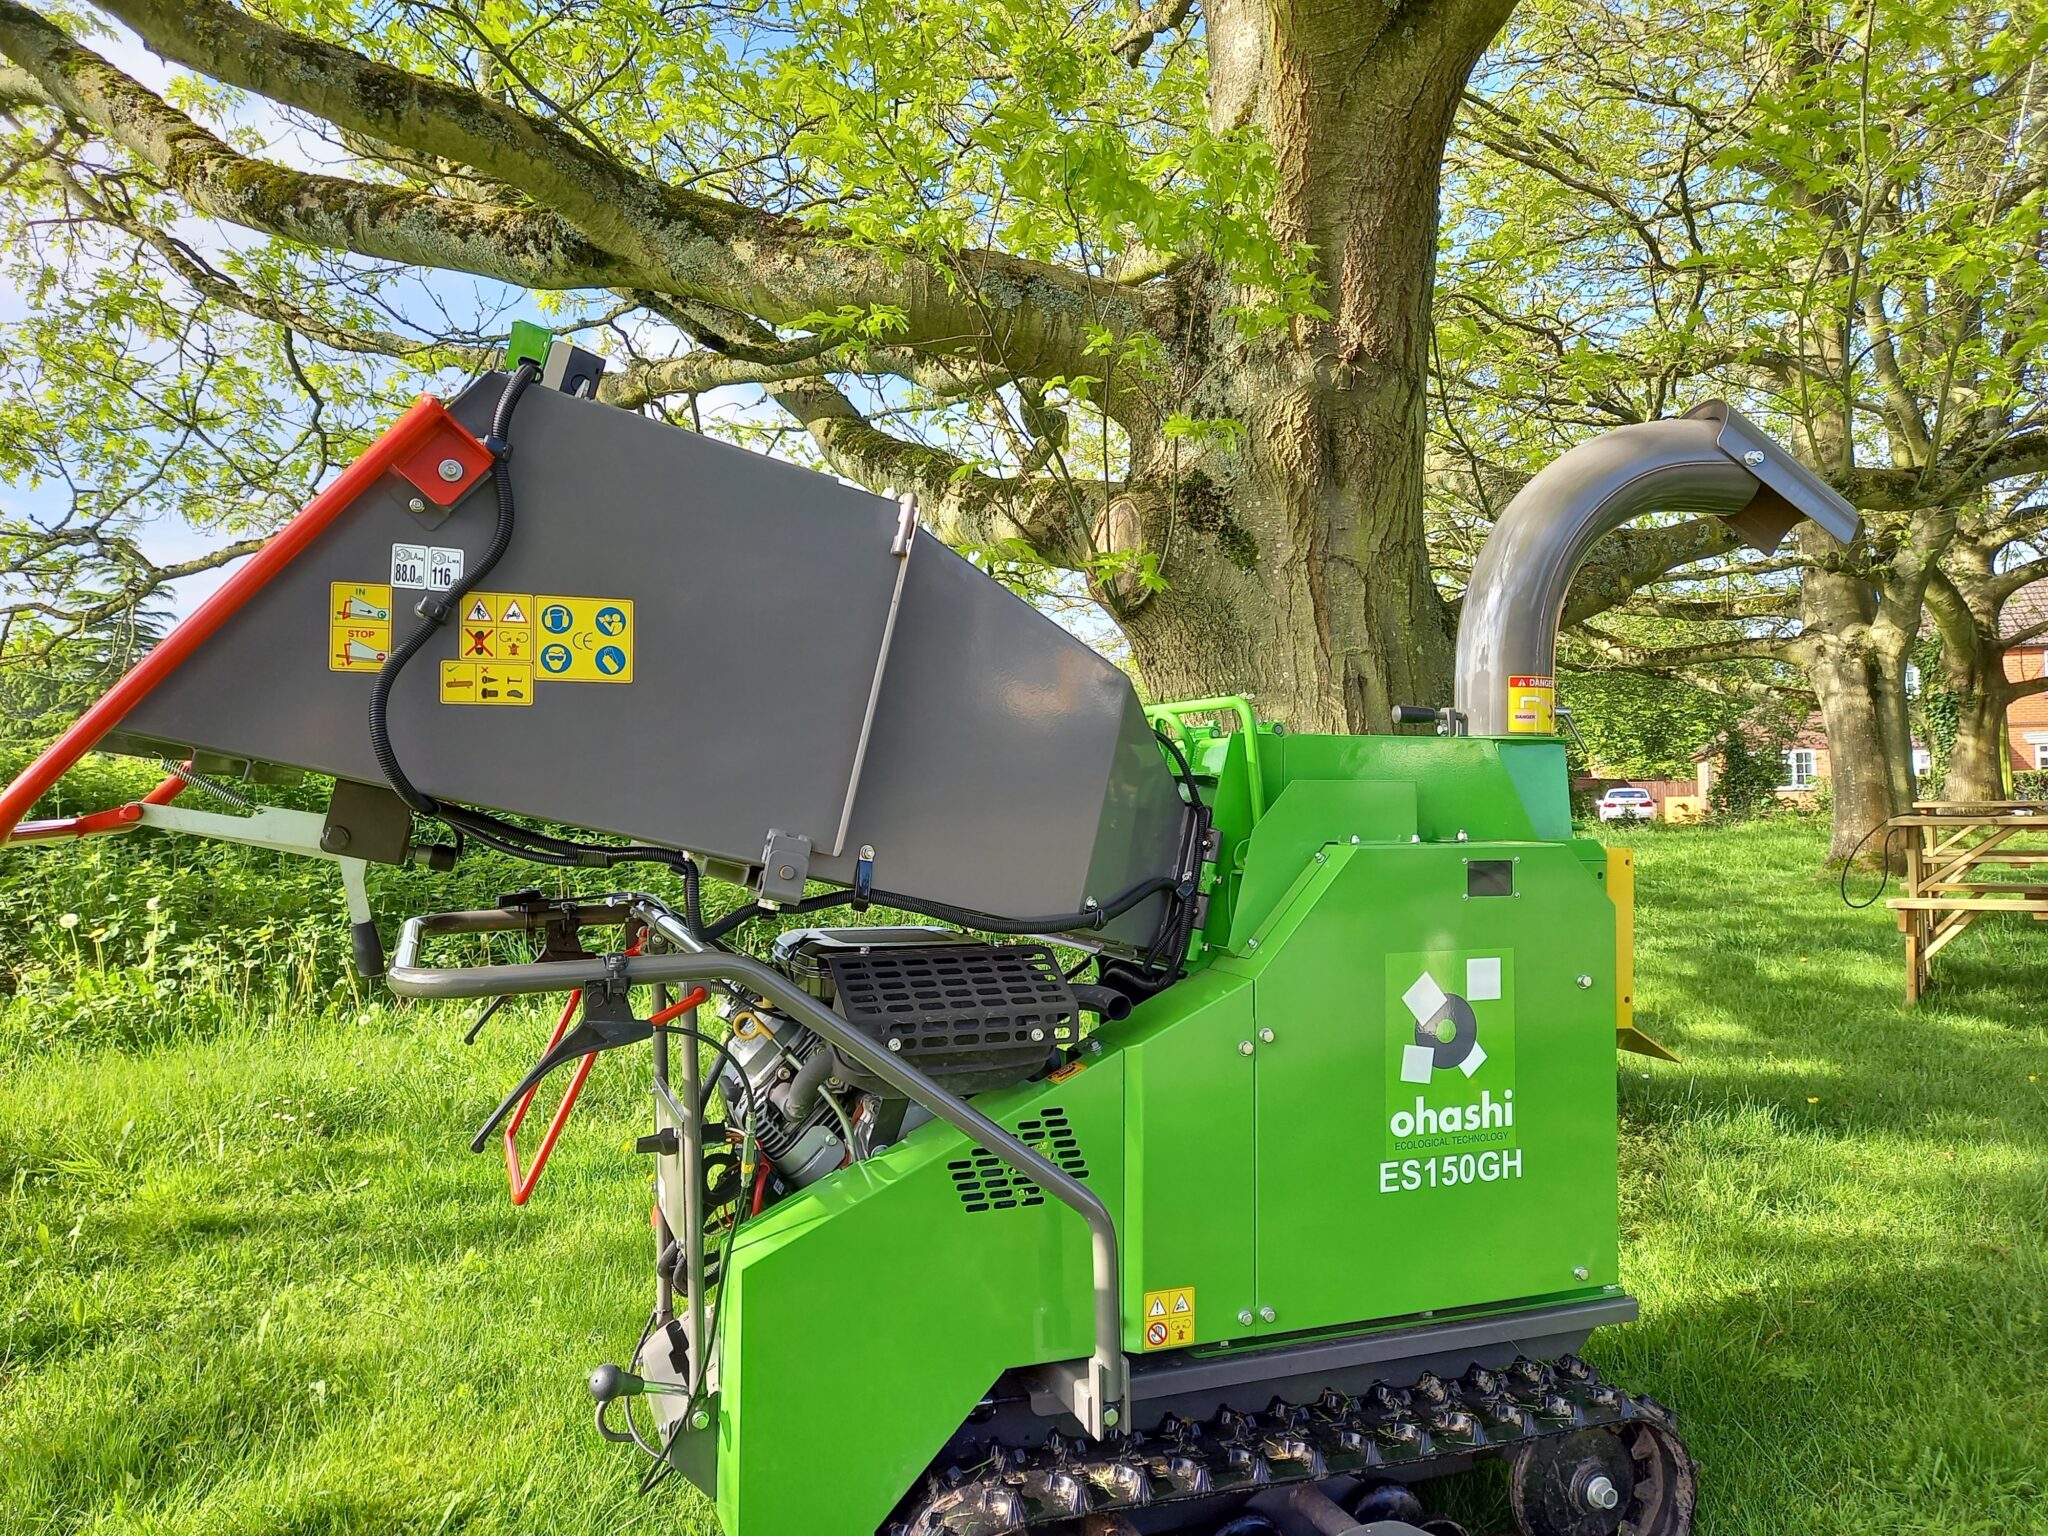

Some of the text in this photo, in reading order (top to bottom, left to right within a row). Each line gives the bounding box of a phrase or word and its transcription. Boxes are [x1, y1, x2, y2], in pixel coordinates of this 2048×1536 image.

[432, 567, 451, 586] 116
[355, 588, 365, 596] IN
[347, 630, 375, 638] STOP
[572, 631, 593, 651] CE
[1390, 1089, 1513, 1138] ohashi
[1395, 1131, 1509, 1150] ECOLOGICAL TECHNOLOGY
[1379, 1148, 1523, 1194] ES150GH
